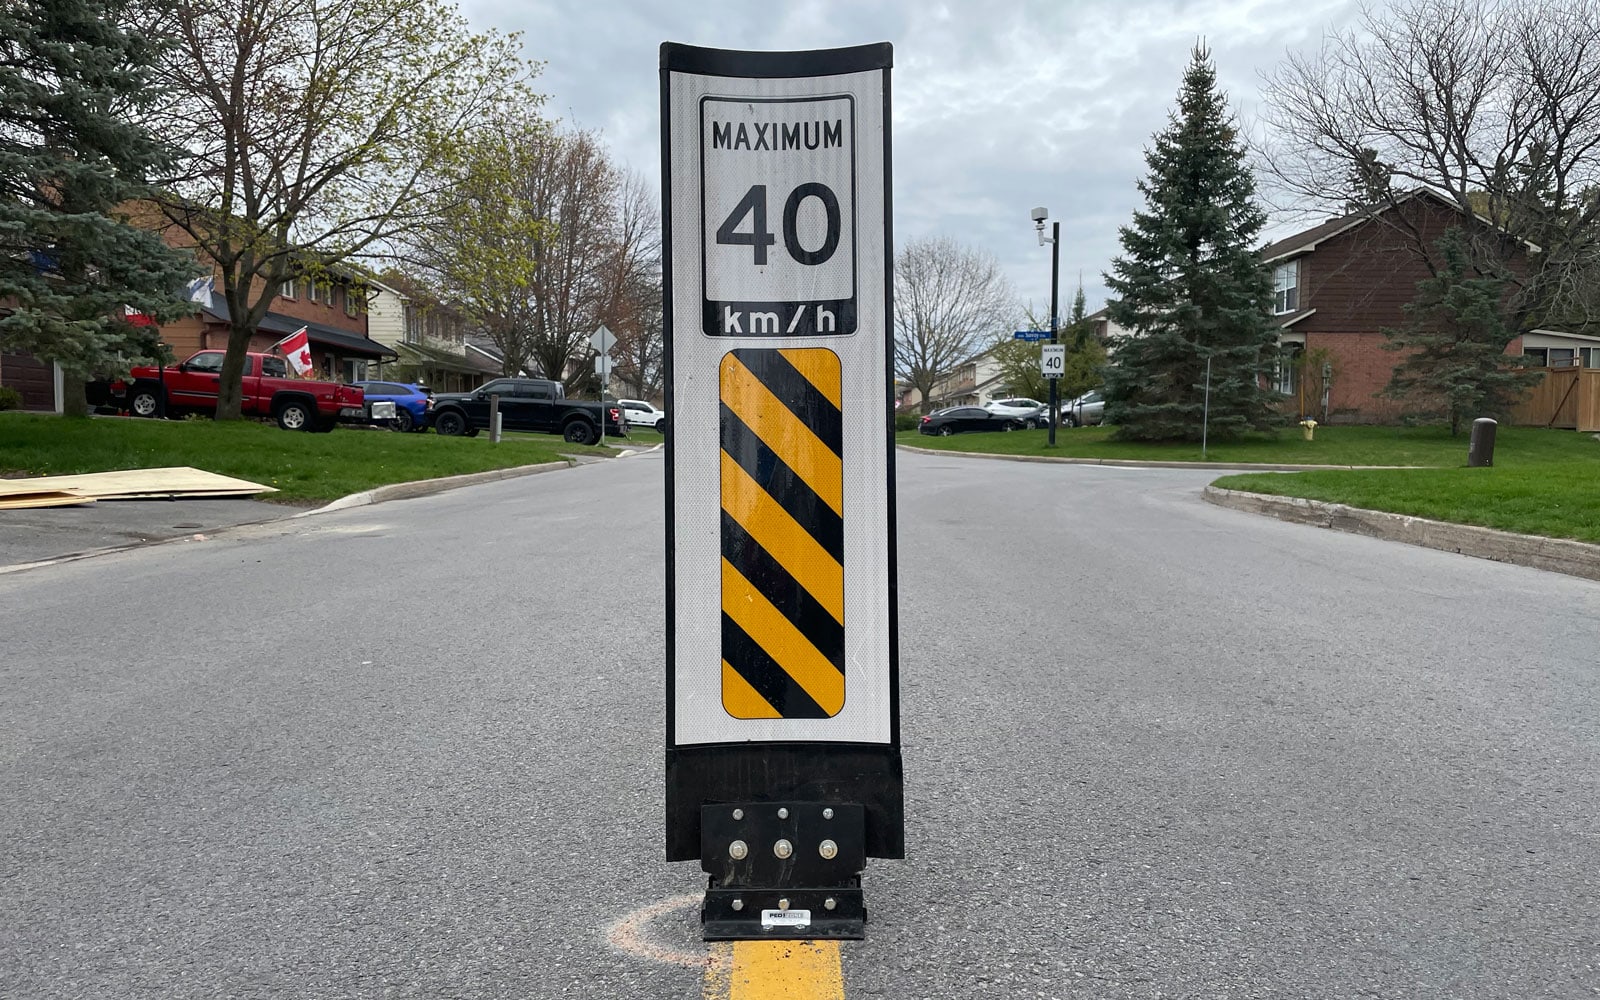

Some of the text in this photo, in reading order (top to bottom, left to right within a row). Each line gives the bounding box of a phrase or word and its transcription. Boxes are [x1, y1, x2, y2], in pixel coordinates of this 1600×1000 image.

[712, 119, 843, 151] MAXIMUM
[716, 182, 842, 266] 40
[724, 304, 836, 334] km/h
[1046, 356, 1061, 369] 40
